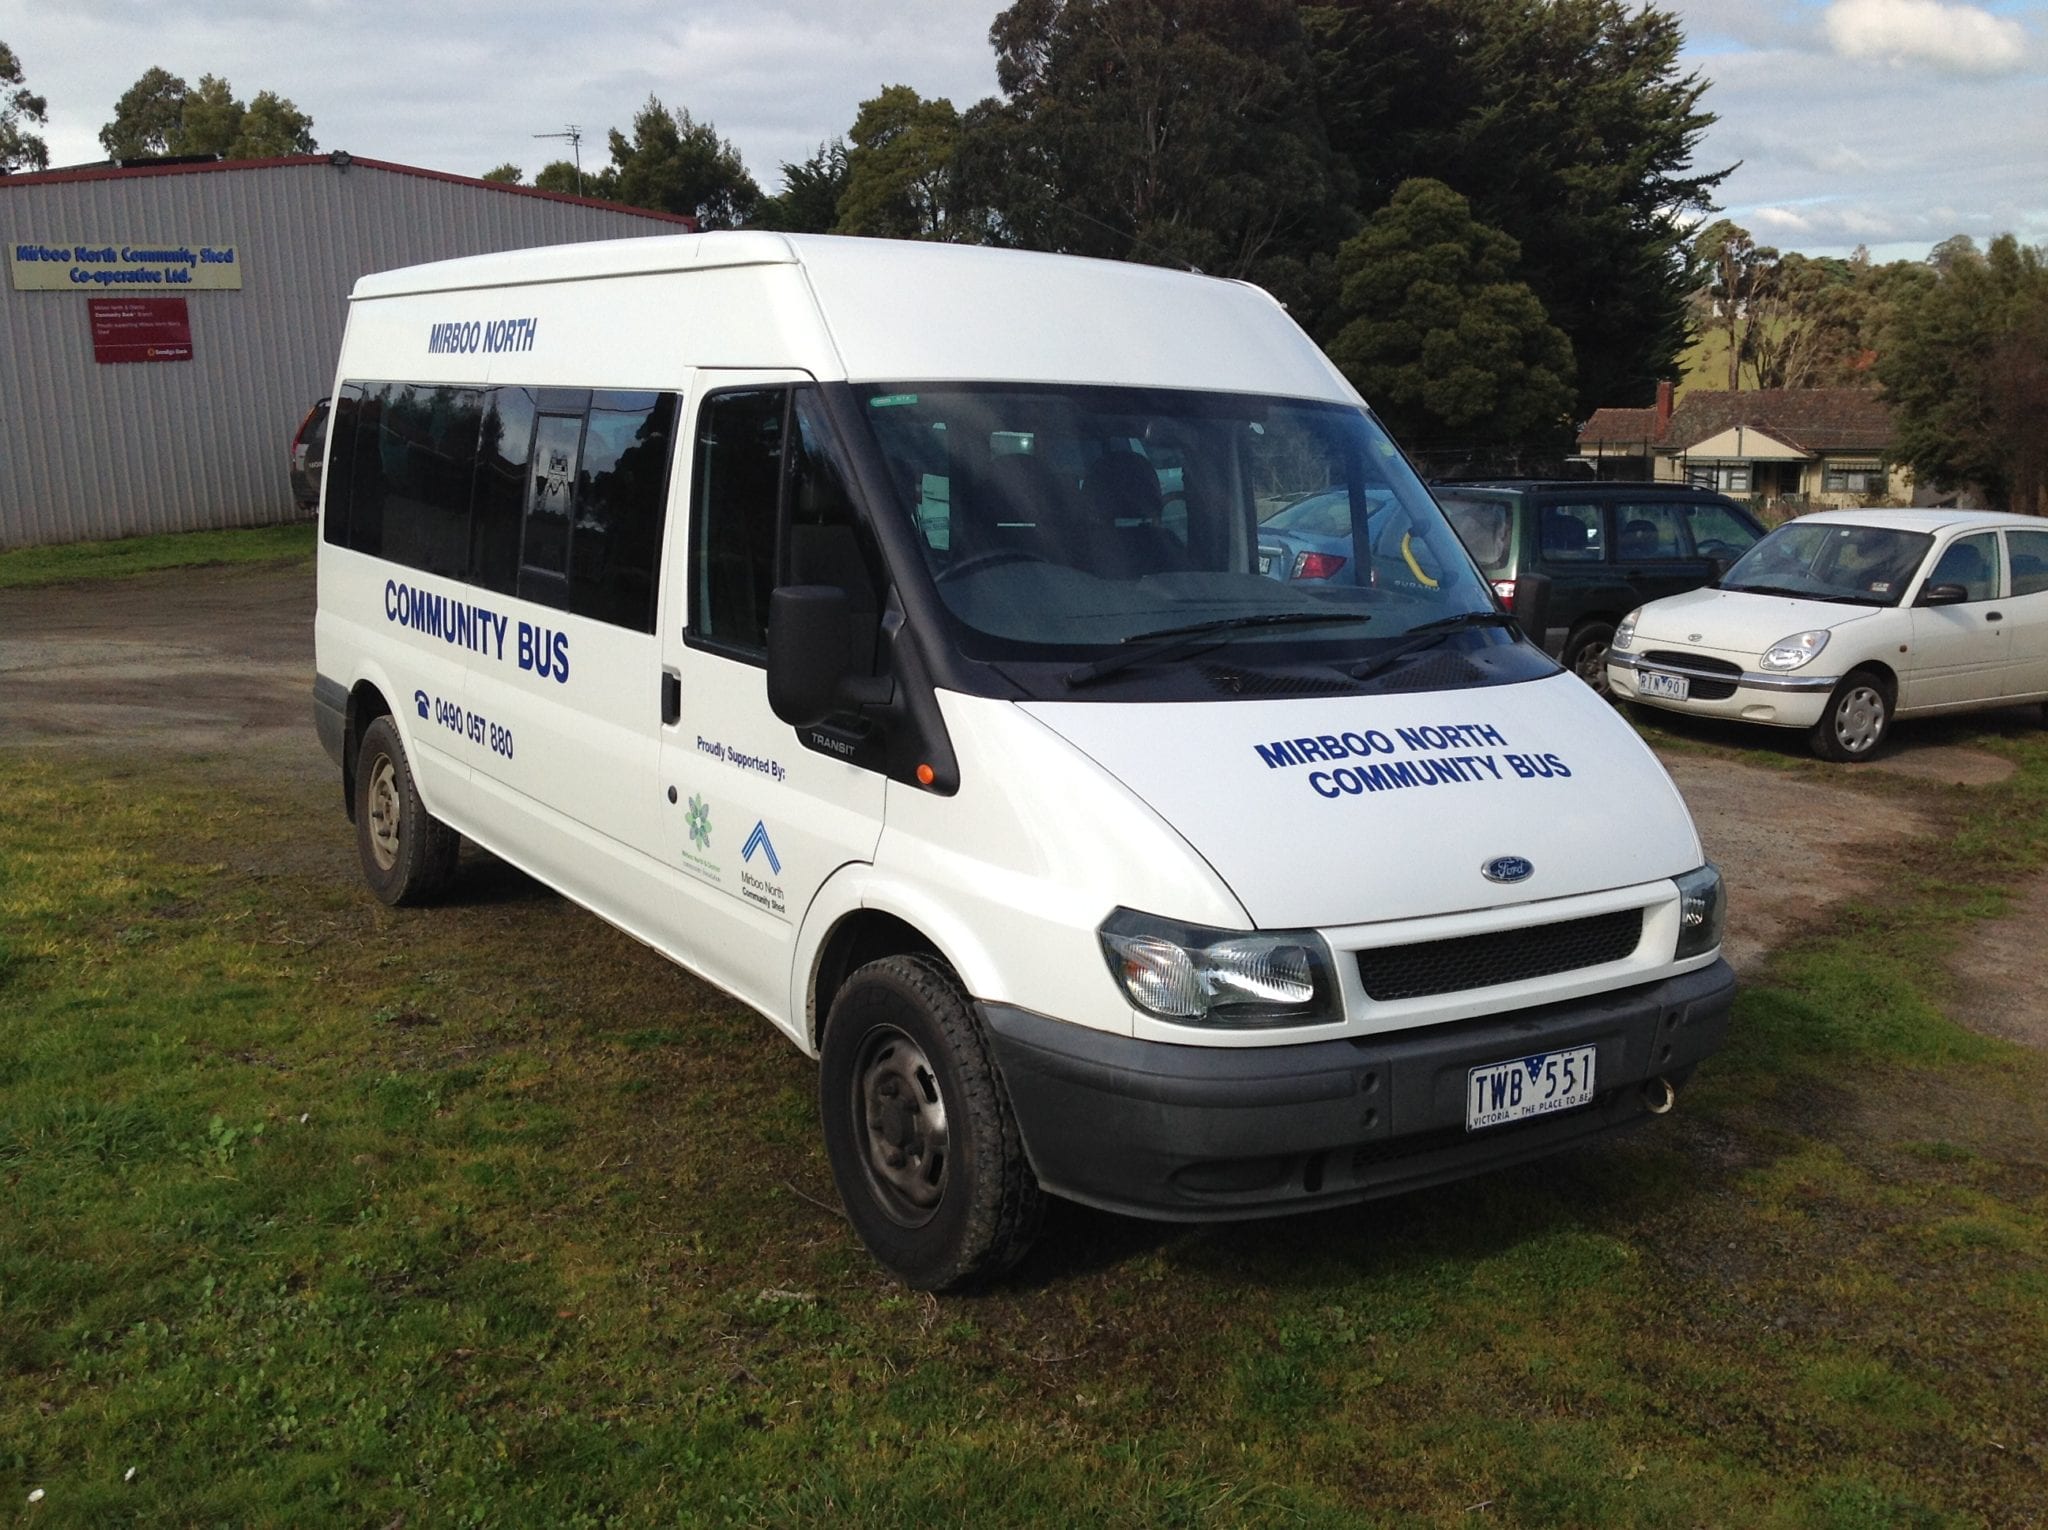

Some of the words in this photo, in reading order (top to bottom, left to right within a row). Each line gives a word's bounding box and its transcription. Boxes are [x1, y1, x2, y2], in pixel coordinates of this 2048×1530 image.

[16, 245, 71, 262] Mirboo
[75, 247, 117, 262] North
[122, 246, 197, 268] Community
[200, 248, 234, 263] Shed
[70, 267, 162, 286] Co-operative
[165, 268, 192, 283] Ltd.
[428, 321, 481, 354] MIRBOO
[482, 318, 538, 353] NORTH
[385, 579, 508, 661] COMMUNITY
[518, 621, 569, 684] BUS
[1668, 679, 1686, 696] 901
[435, 697, 463, 735] 0490
[466, 711, 486, 746] 057
[490, 722, 514, 760] 880
[811, 732, 855, 756] TRANSIT
[697, 735, 725, 762] Proudly
[728, 746, 769, 773] Supported
[771, 760, 786, 782] By:
[1253, 730, 1395, 769] MIRBOO
[1394, 724, 1509, 751] NORTH
[1309, 755, 1503, 799] COMMUNITY
[1505, 753, 1572, 778] BUS
[741, 871, 763, 891] Mirboo
[765, 881, 785, 900] North
[742, 886, 770, 909] Community
[772, 899, 785, 914] Shed
[1476, 1068, 1523, 1114] TWB
[1545, 1054, 1589, 1099] 551
[1473, 1110, 1510, 1126] VICTORIA
[1521, 1103, 1535, 1116] THE
[1539, 1097, 1562, 1111] PLACE
[1566, 1095, 1576, 1105] TO
